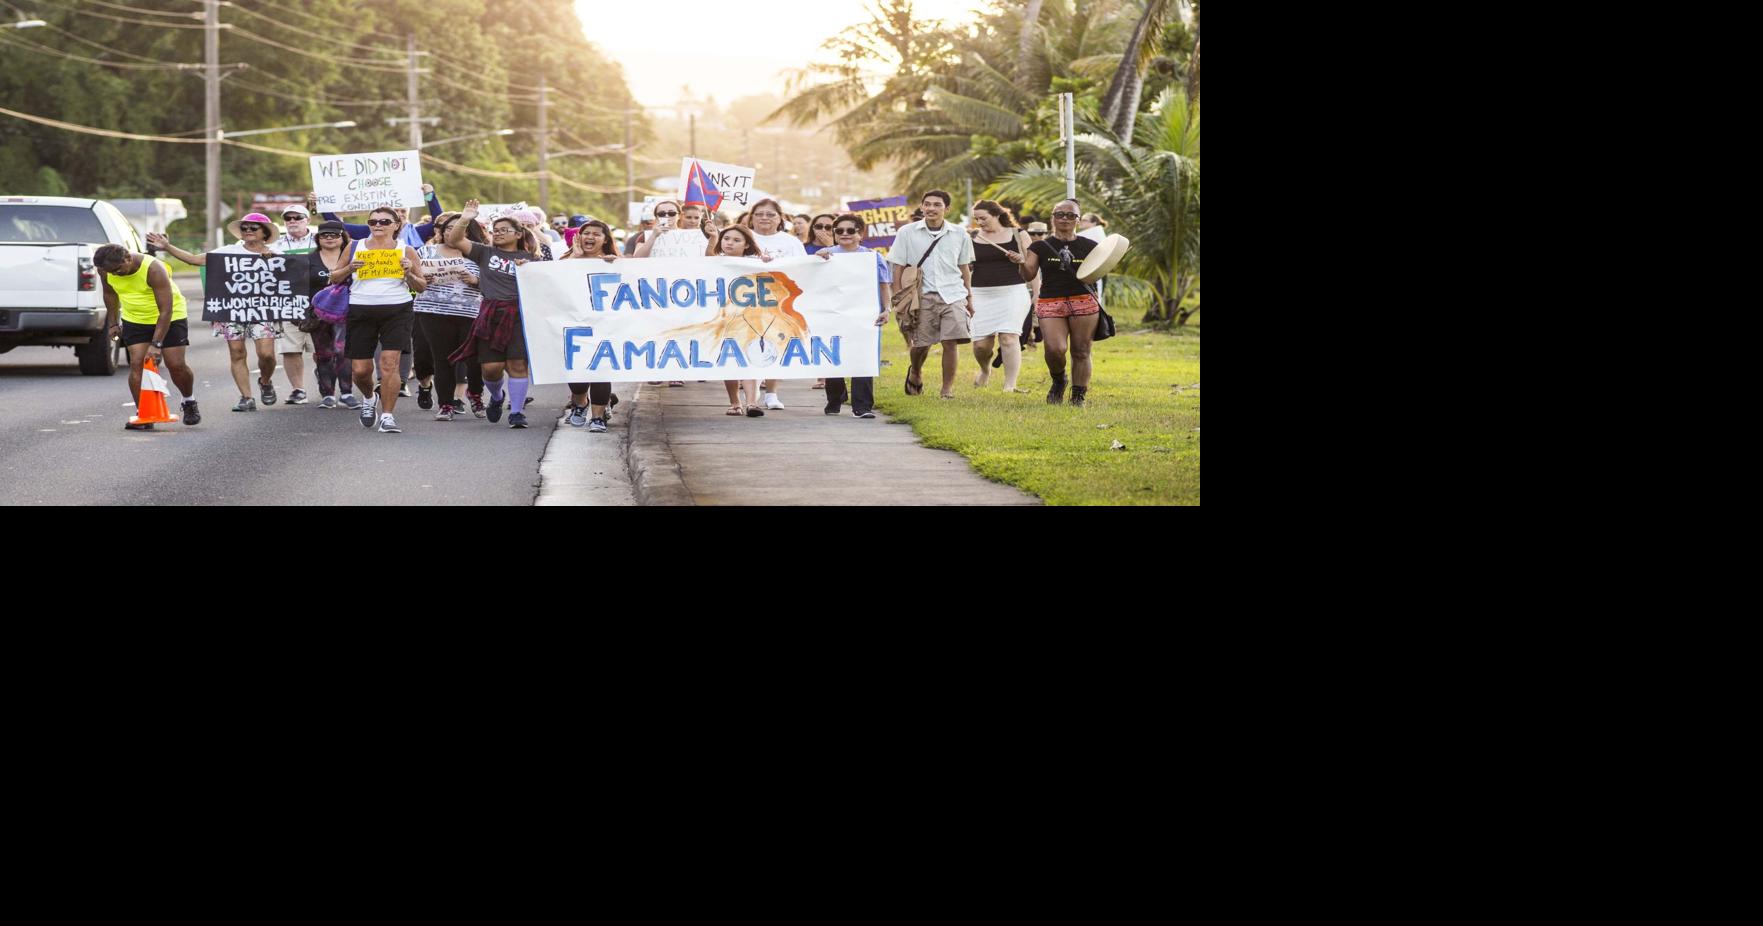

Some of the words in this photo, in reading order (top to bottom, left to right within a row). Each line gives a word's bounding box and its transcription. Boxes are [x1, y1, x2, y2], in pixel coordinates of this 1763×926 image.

[318, 160, 346, 177] WE
[354, 157, 379, 175] DID
[383, 157, 408, 172] NOT
[348, 176, 392, 190] CHOOSE
[733, 175, 751, 188] IT
[318, 195, 336, 204] PRE
[344, 189, 398, 203] EXISTING
[341, 199, 404, 211] CONDITIONS
[224, 256, 286, 273] HEAR
[438, 258, 464, 267] LIVES
[231, 270, 277, 283] OUR
[225, 280, 292, 296] VOICE
[587, 272, 779, 311] FANOHGE
[230, 306, 306, 322] MATTER
